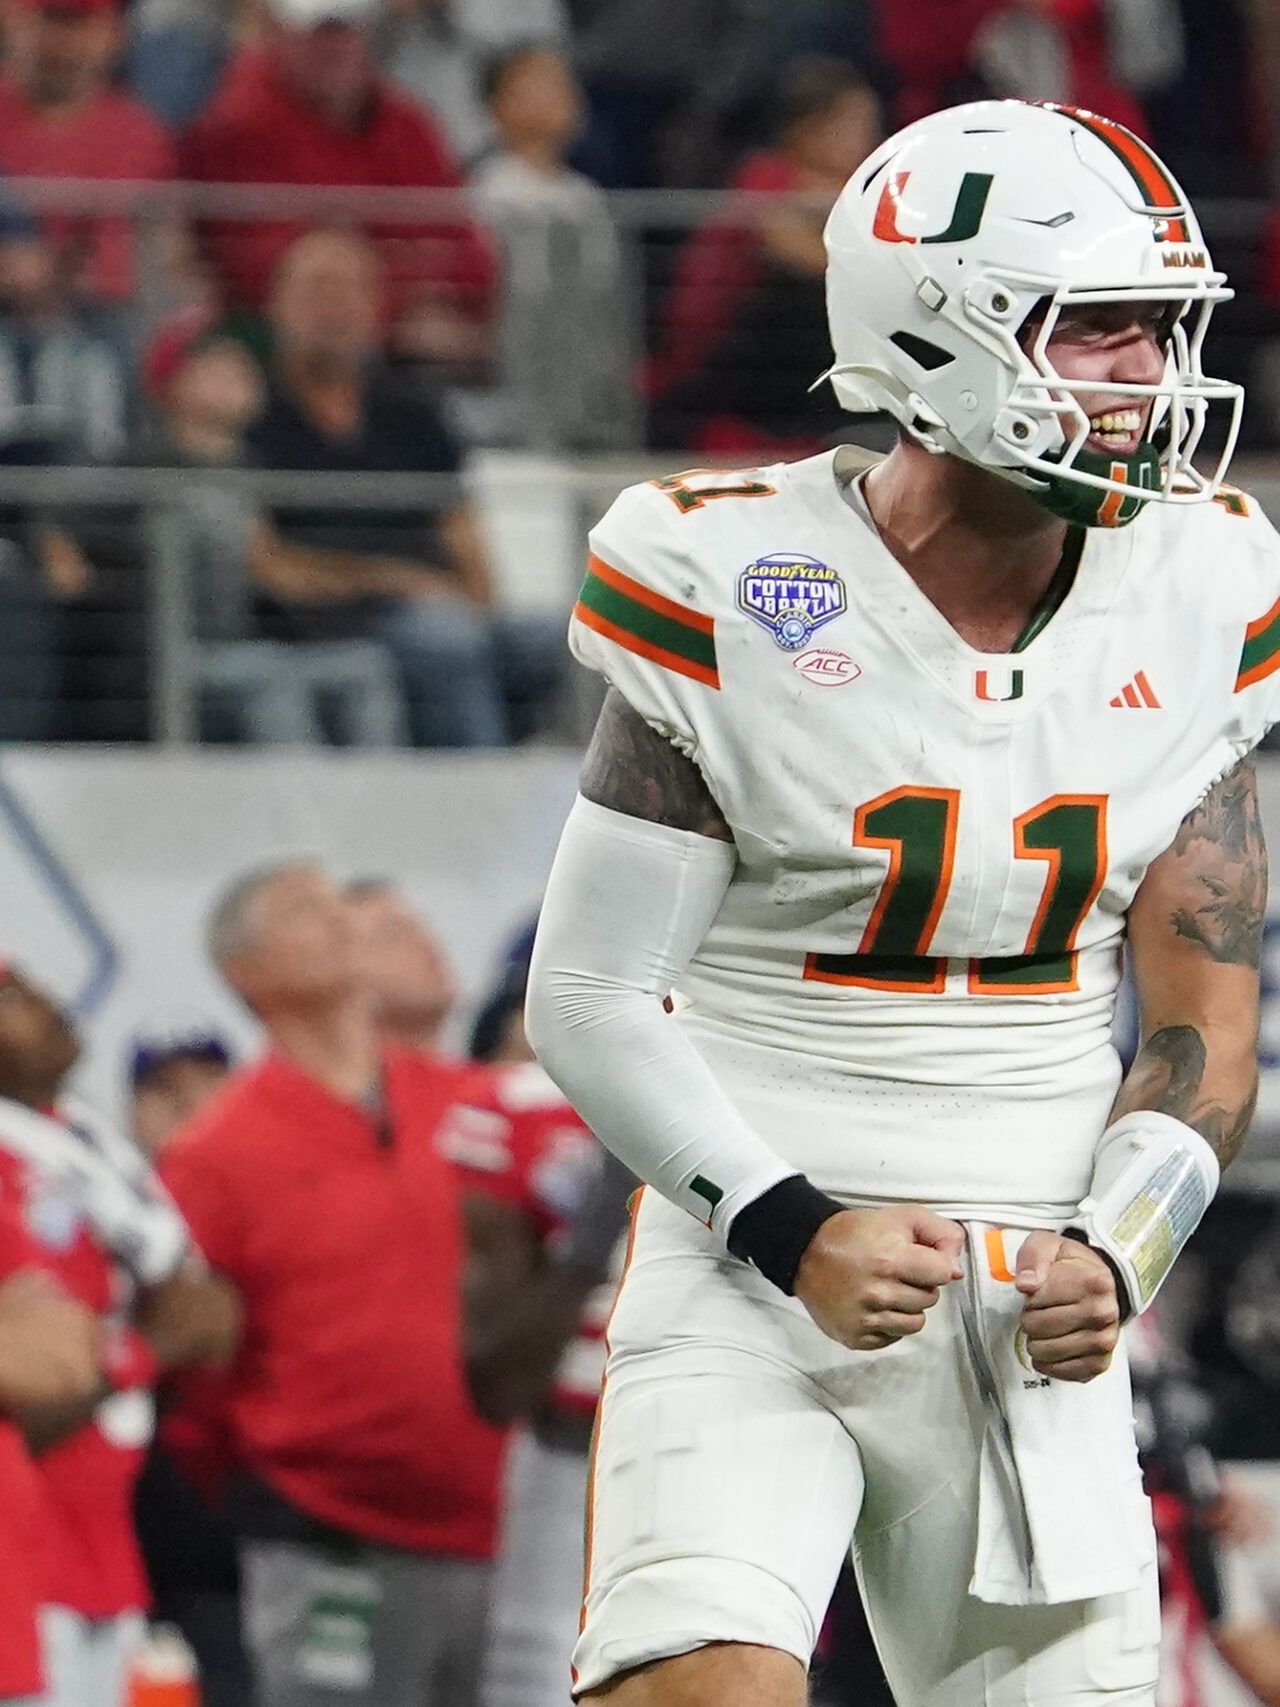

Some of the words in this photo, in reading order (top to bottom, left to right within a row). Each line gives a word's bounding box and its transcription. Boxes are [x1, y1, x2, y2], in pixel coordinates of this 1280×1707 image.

[872, 172, 995, 245] U
[1162, 250, 1206, 269] MIAMI
[748, 564, 836, 579] GOODYEAR
[746, 578, 841, 611] COTTON
[763, 597, 825, 618] BOWL
[804, 658, 852, 673] ACC
[976, 669, 1024, 702] U
[803, 785, 1109, 994] 11
